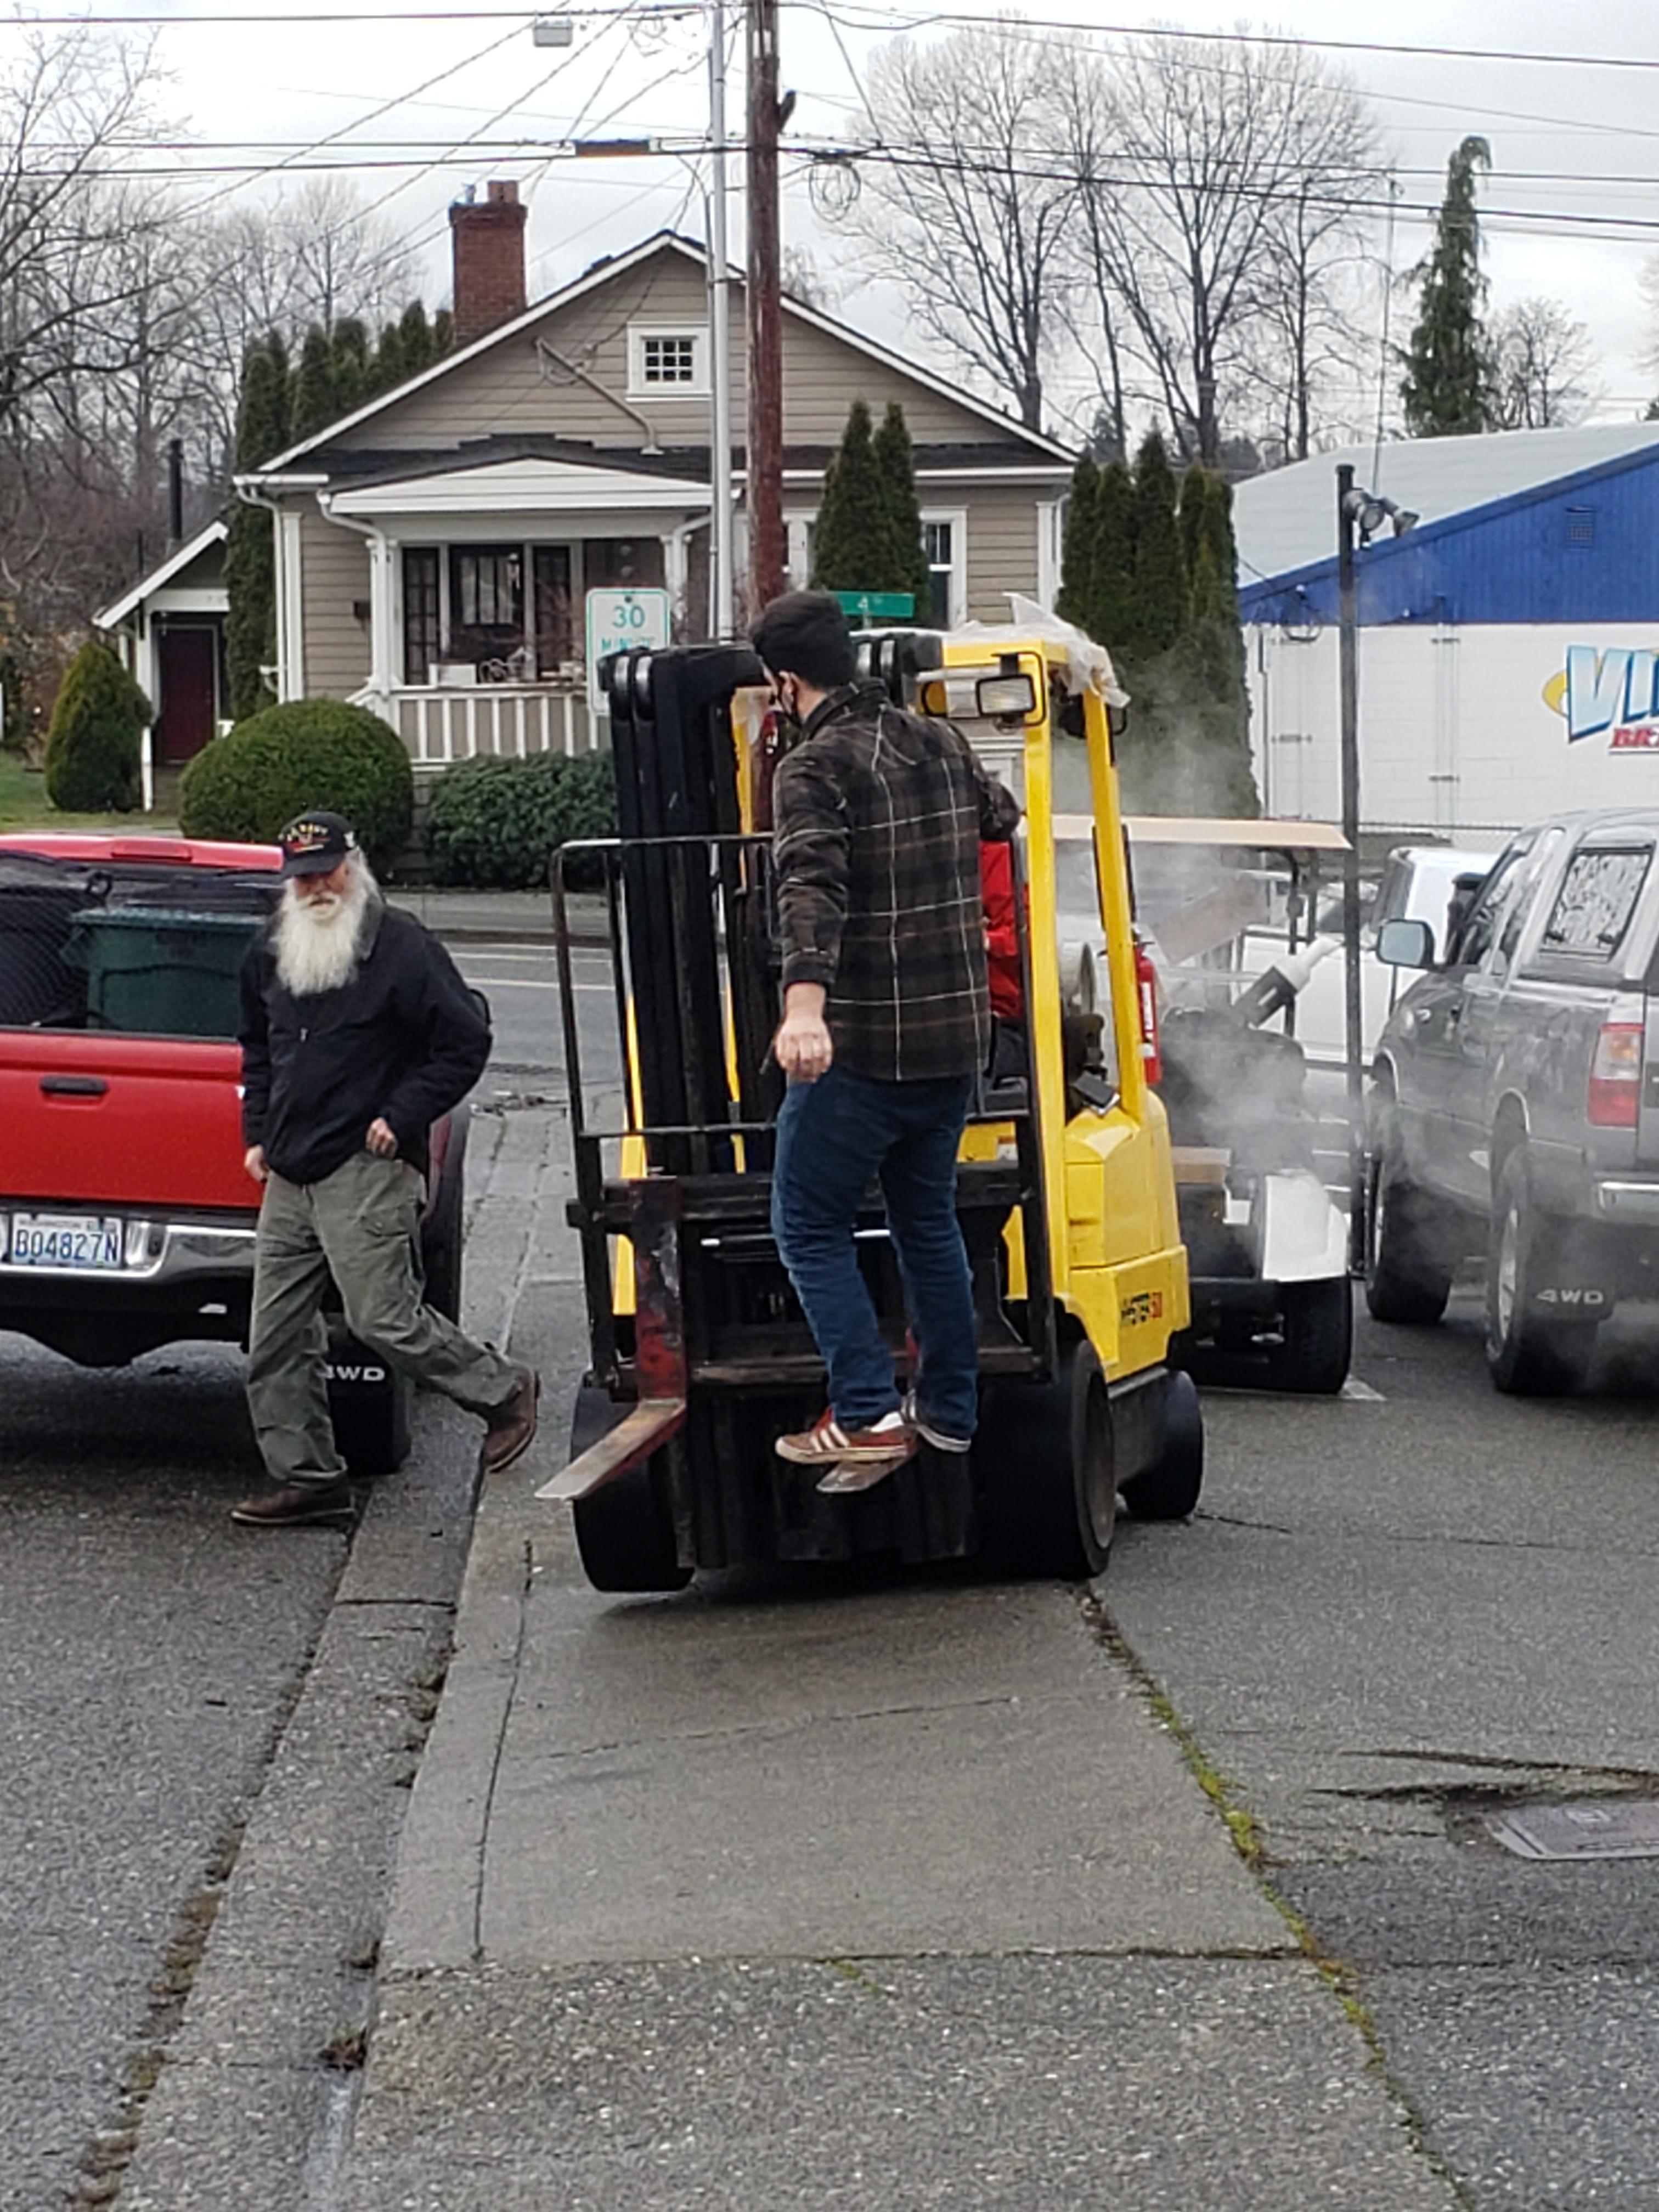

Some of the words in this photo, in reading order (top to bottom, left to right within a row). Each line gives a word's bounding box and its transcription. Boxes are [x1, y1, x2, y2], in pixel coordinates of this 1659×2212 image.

[612, 605, 645, 628] 30
[1566, 644, 1658, 744] VI
[1609, 727, 1658, 748] BR
[15, 1229, 118, 1262] B04827N
[1537, 1289, 1604, 1304] 4WD
